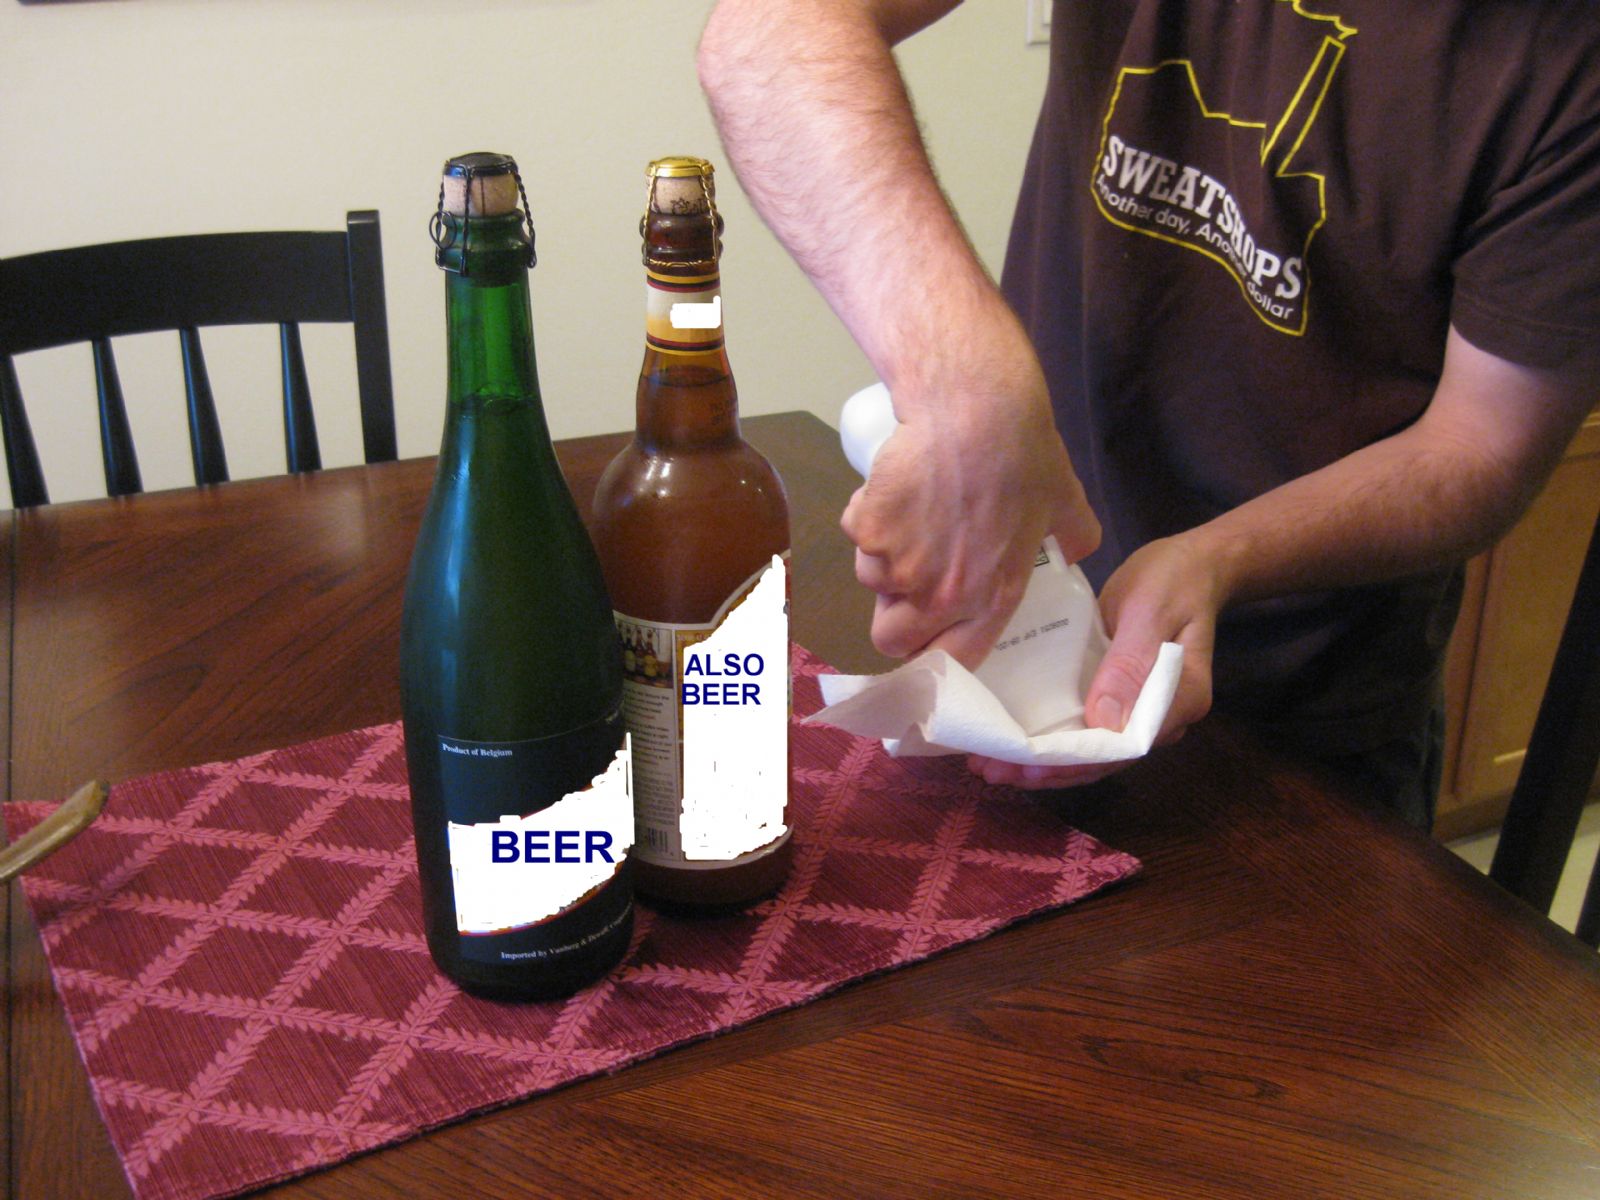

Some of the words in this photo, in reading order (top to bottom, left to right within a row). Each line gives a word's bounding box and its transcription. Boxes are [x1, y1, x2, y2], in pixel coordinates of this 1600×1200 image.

[1102, 135, 1302, 299] SWEATSHOPS
[1155, 207, 1192, 235] day,
[1246, 281, 1294, 320] dollar
[442, 743, 470, 756] Product
[471, 748, 479, 756] of
[480, 748, 513, 758] Belgium
[501, 951, 536, 960] Imported
